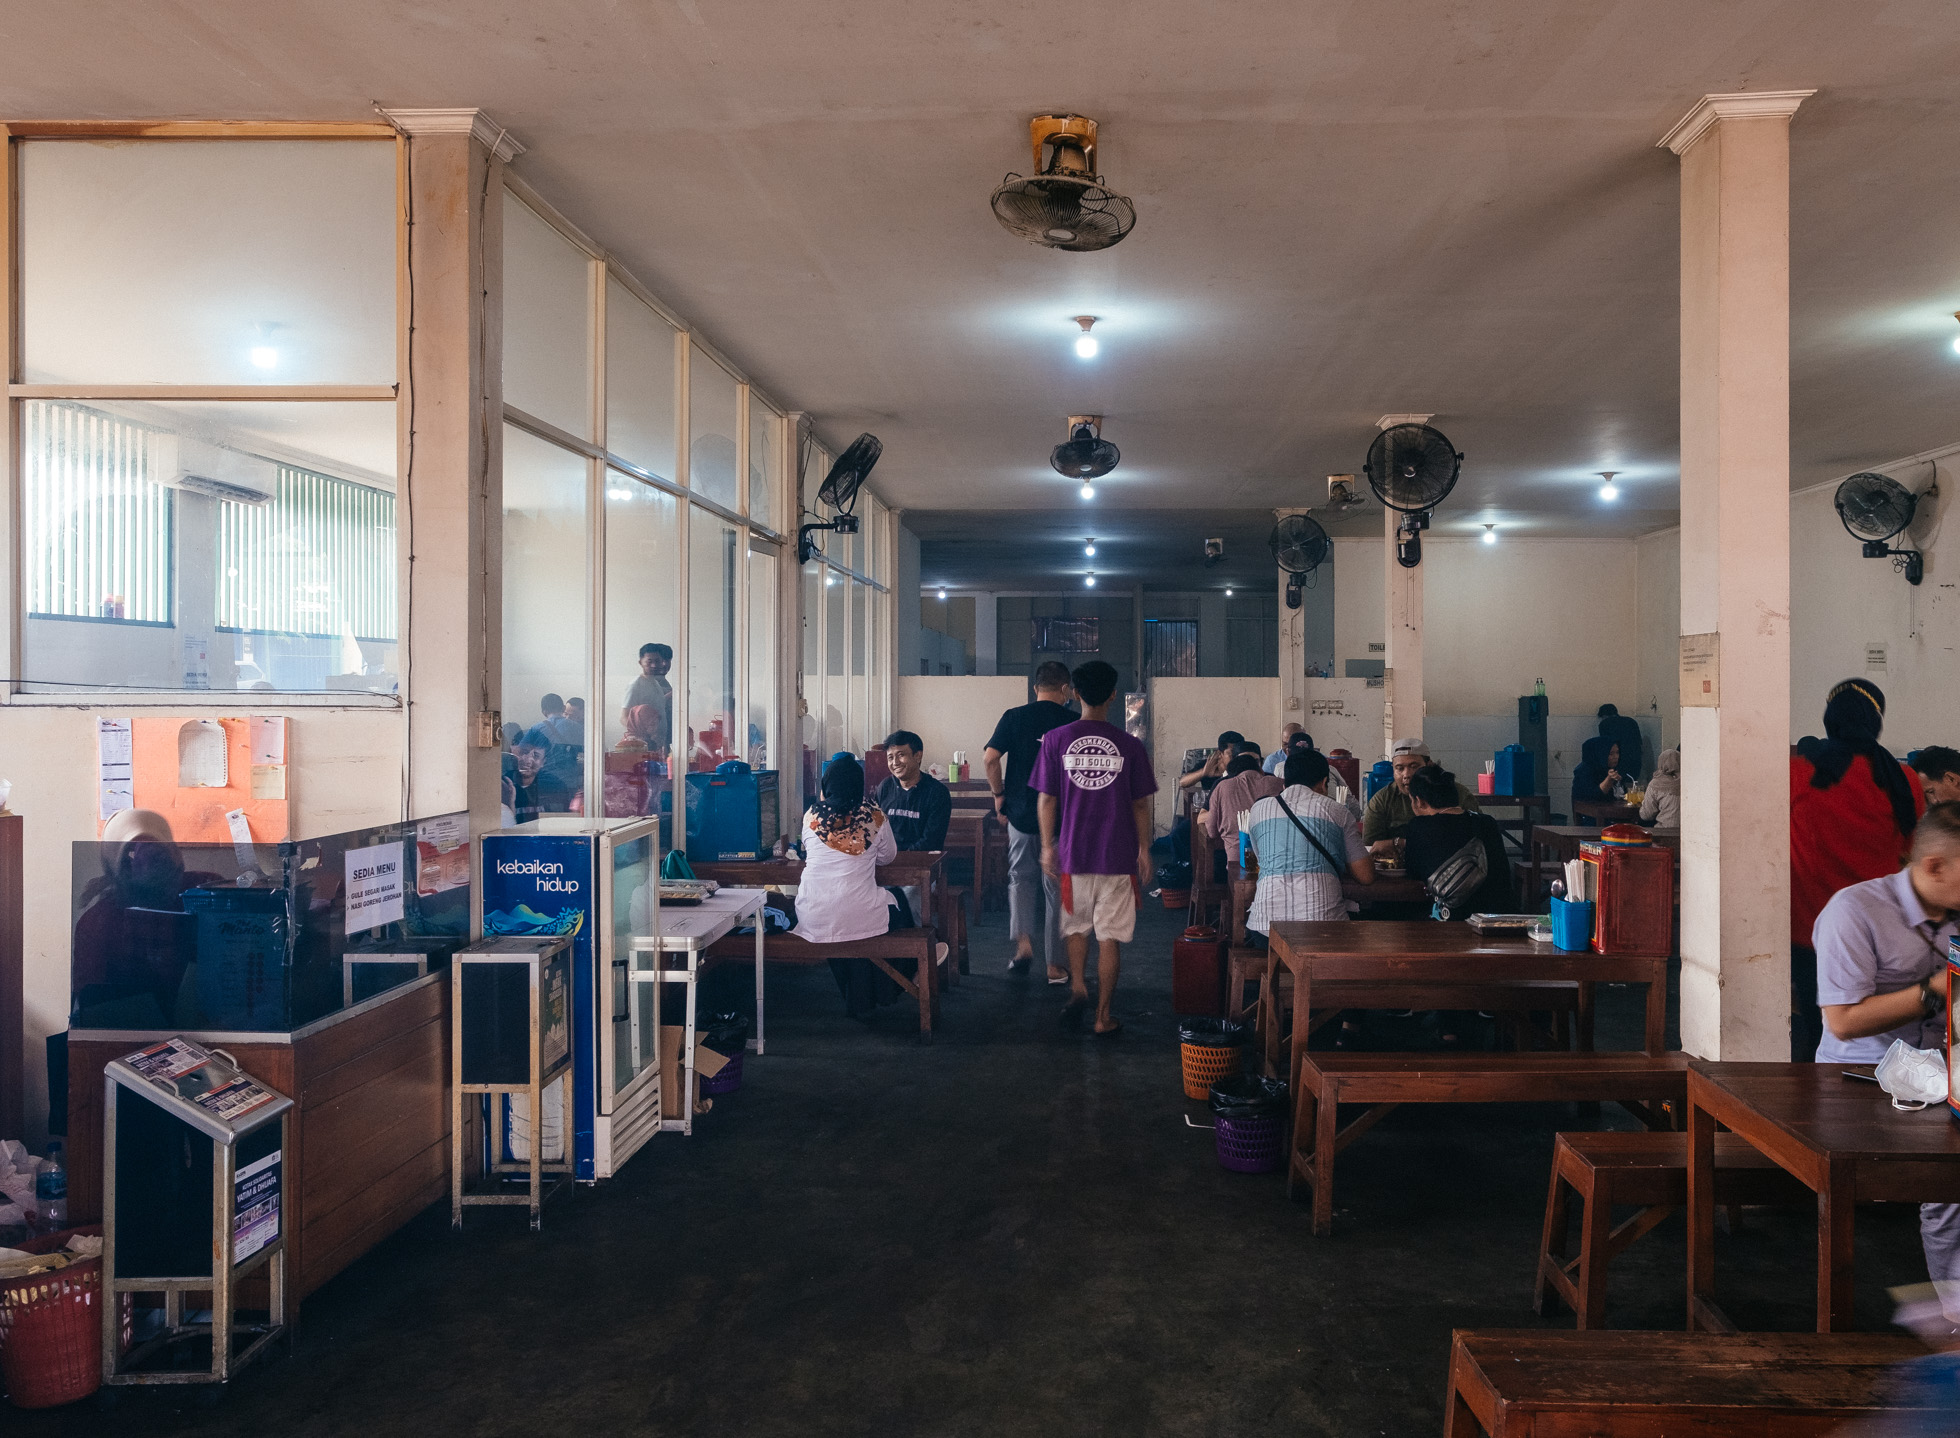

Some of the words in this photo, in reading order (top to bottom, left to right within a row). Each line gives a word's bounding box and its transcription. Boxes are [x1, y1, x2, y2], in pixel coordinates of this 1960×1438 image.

[1075, 758, 1084, 766] DI
[1088, 758, 1111, 767] SOLO
[353, 867, 375, 879] SEDIA
[376, 862, 396, 875] MENU
[497, 859, 563, 874] kebaikan
[536, 877, 579, 894] hidup
[351, 891, 363, 899] GULE
[351, 902, 363, 910] NASI
[253, 1186, 257, 1195] &
